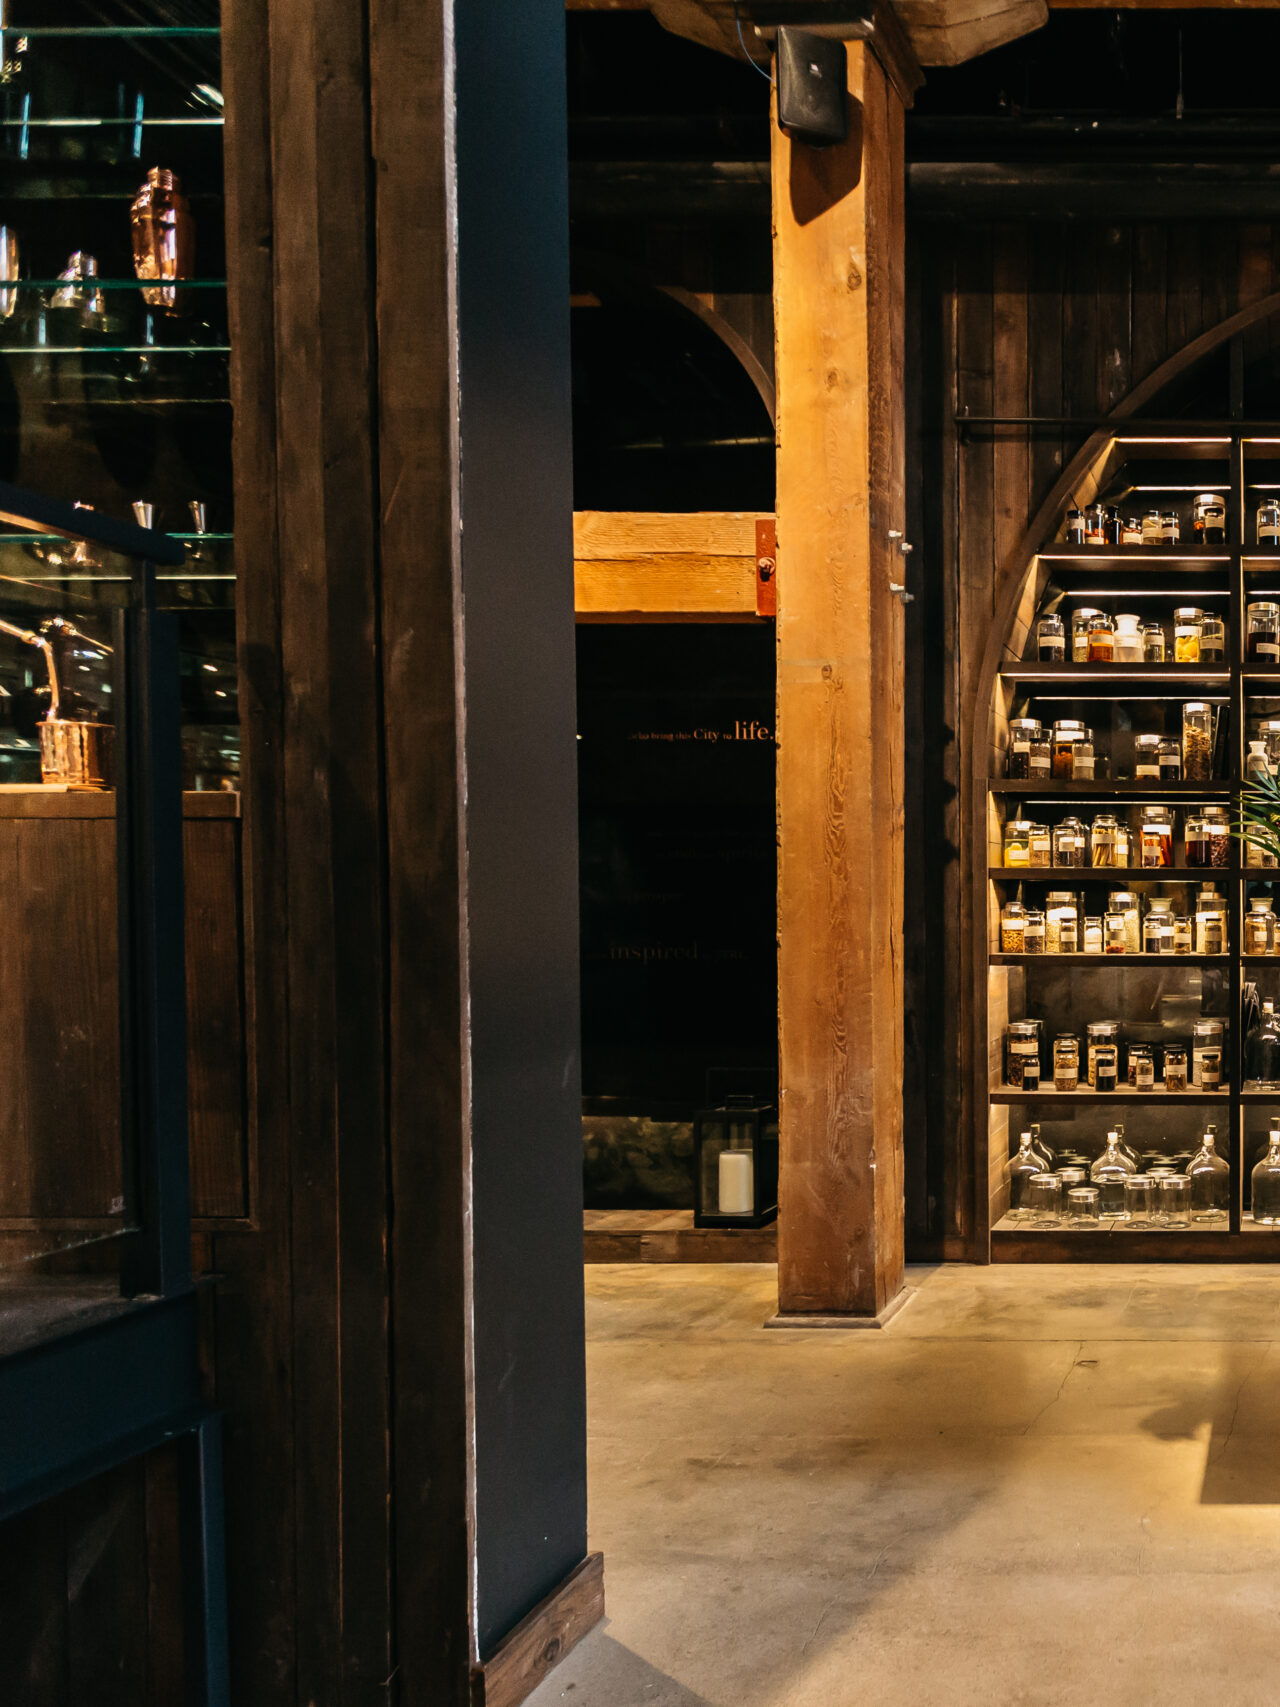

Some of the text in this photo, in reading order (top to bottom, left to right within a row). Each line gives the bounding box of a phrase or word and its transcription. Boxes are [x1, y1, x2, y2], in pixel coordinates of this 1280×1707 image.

[693, 728, 719, 743] City
[734, 720, 774, 741] life.
[609, 941, 698, 966] inspired
